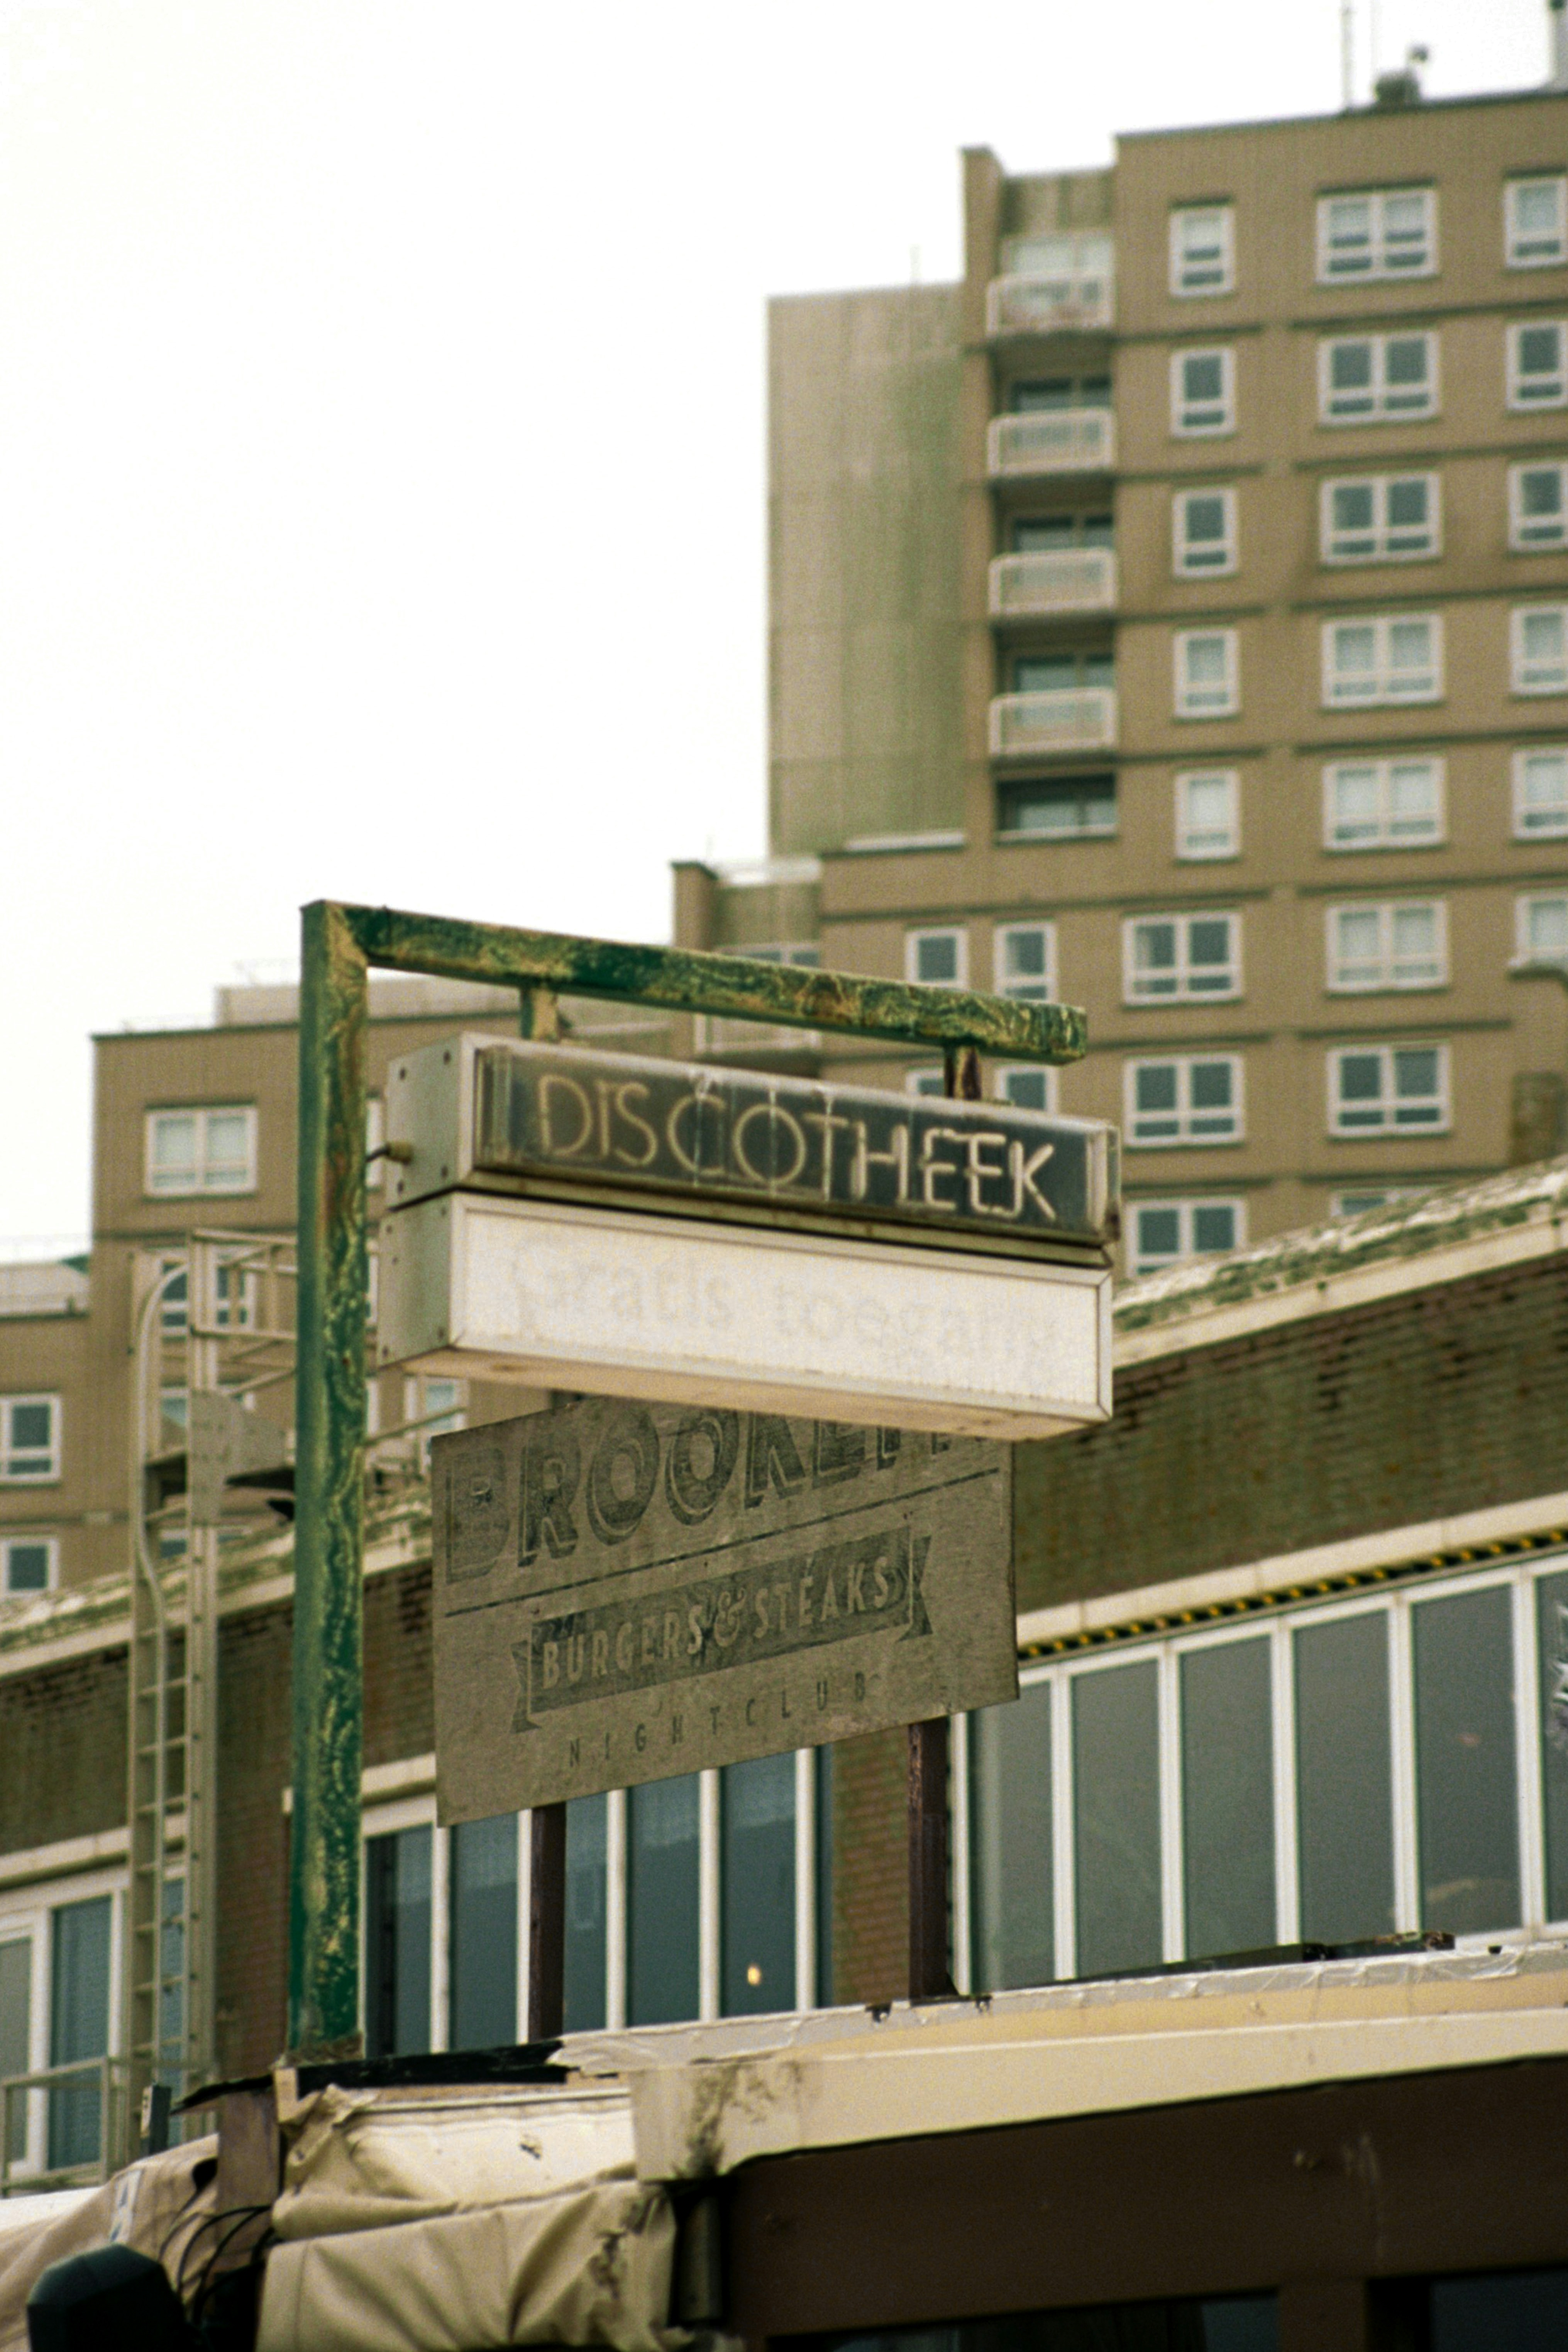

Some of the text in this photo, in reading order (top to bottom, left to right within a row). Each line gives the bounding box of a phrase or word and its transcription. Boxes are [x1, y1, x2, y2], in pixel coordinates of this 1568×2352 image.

[538, 1074, 1057, 1222] DISCOTHEEK
[542, 1556, 889, 1690] BURGERS & STEAKS
